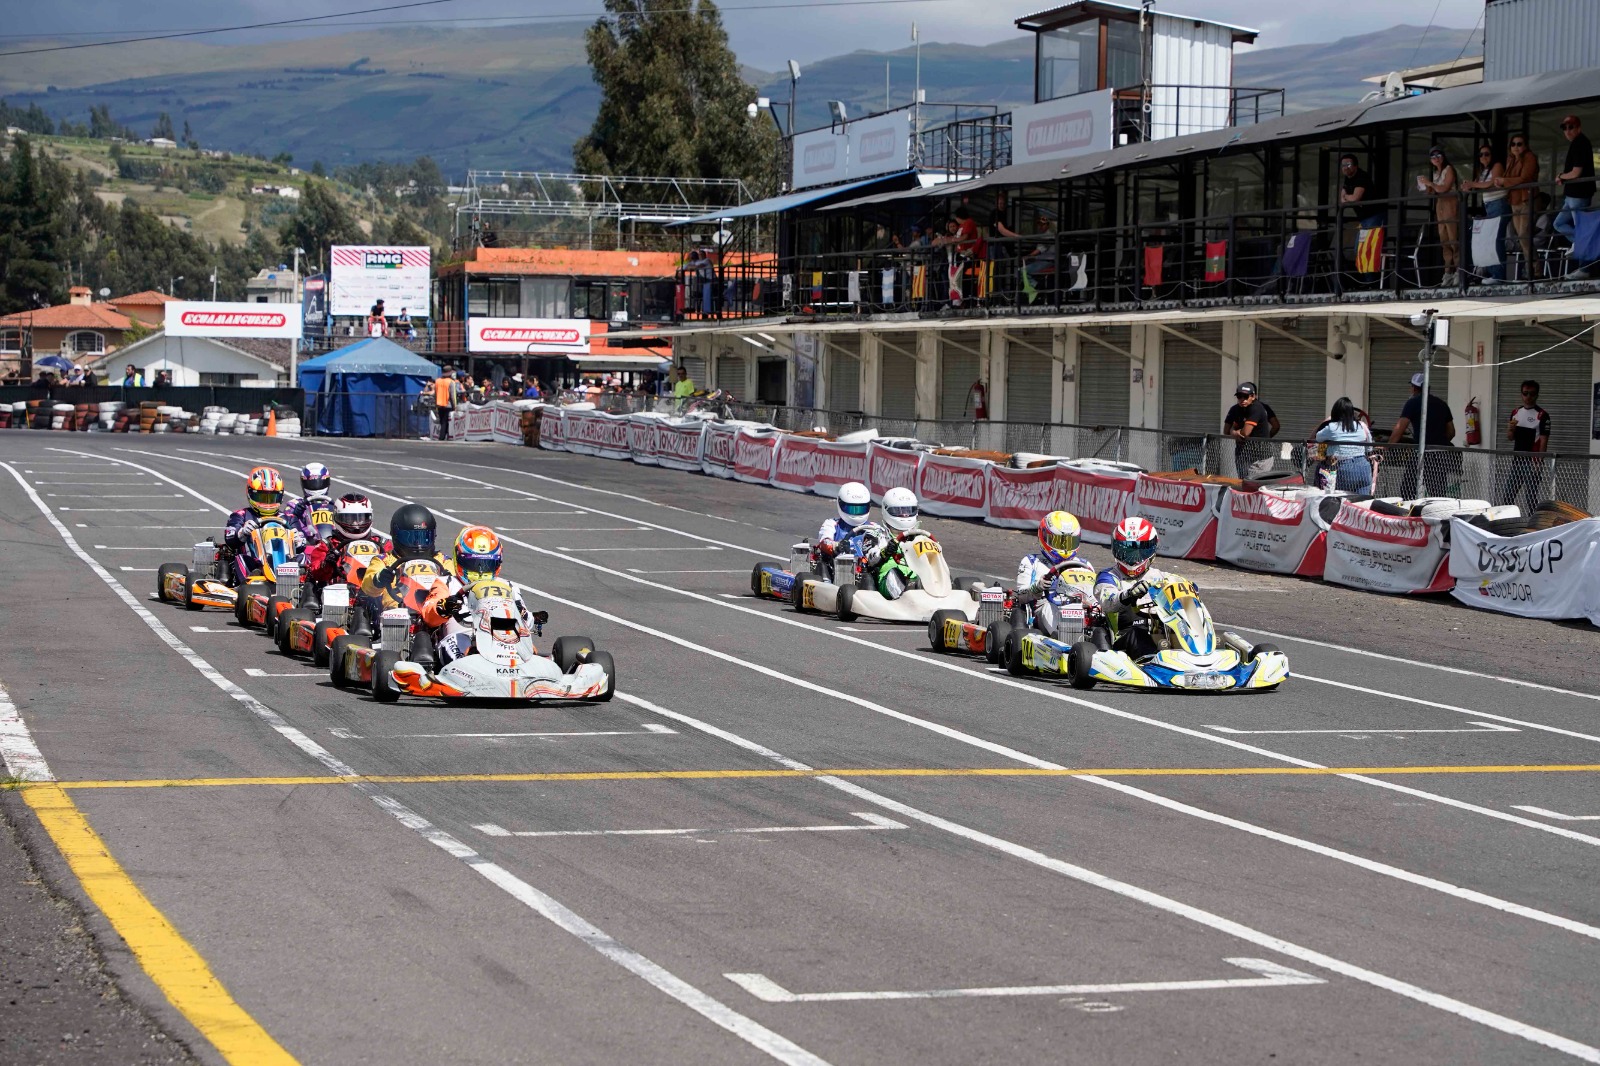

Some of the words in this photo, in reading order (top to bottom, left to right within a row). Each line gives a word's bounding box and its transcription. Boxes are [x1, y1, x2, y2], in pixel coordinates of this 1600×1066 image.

[366, 254, 401, 263] RMC
[184, 313, 283, 325] ECUAMANGUERAS
[482, 329, 577, 341] ECUAMANGUERAS
[1372, 550, 1382, 559] EN
[1383, 552, 1412, 564] CAUCHO
